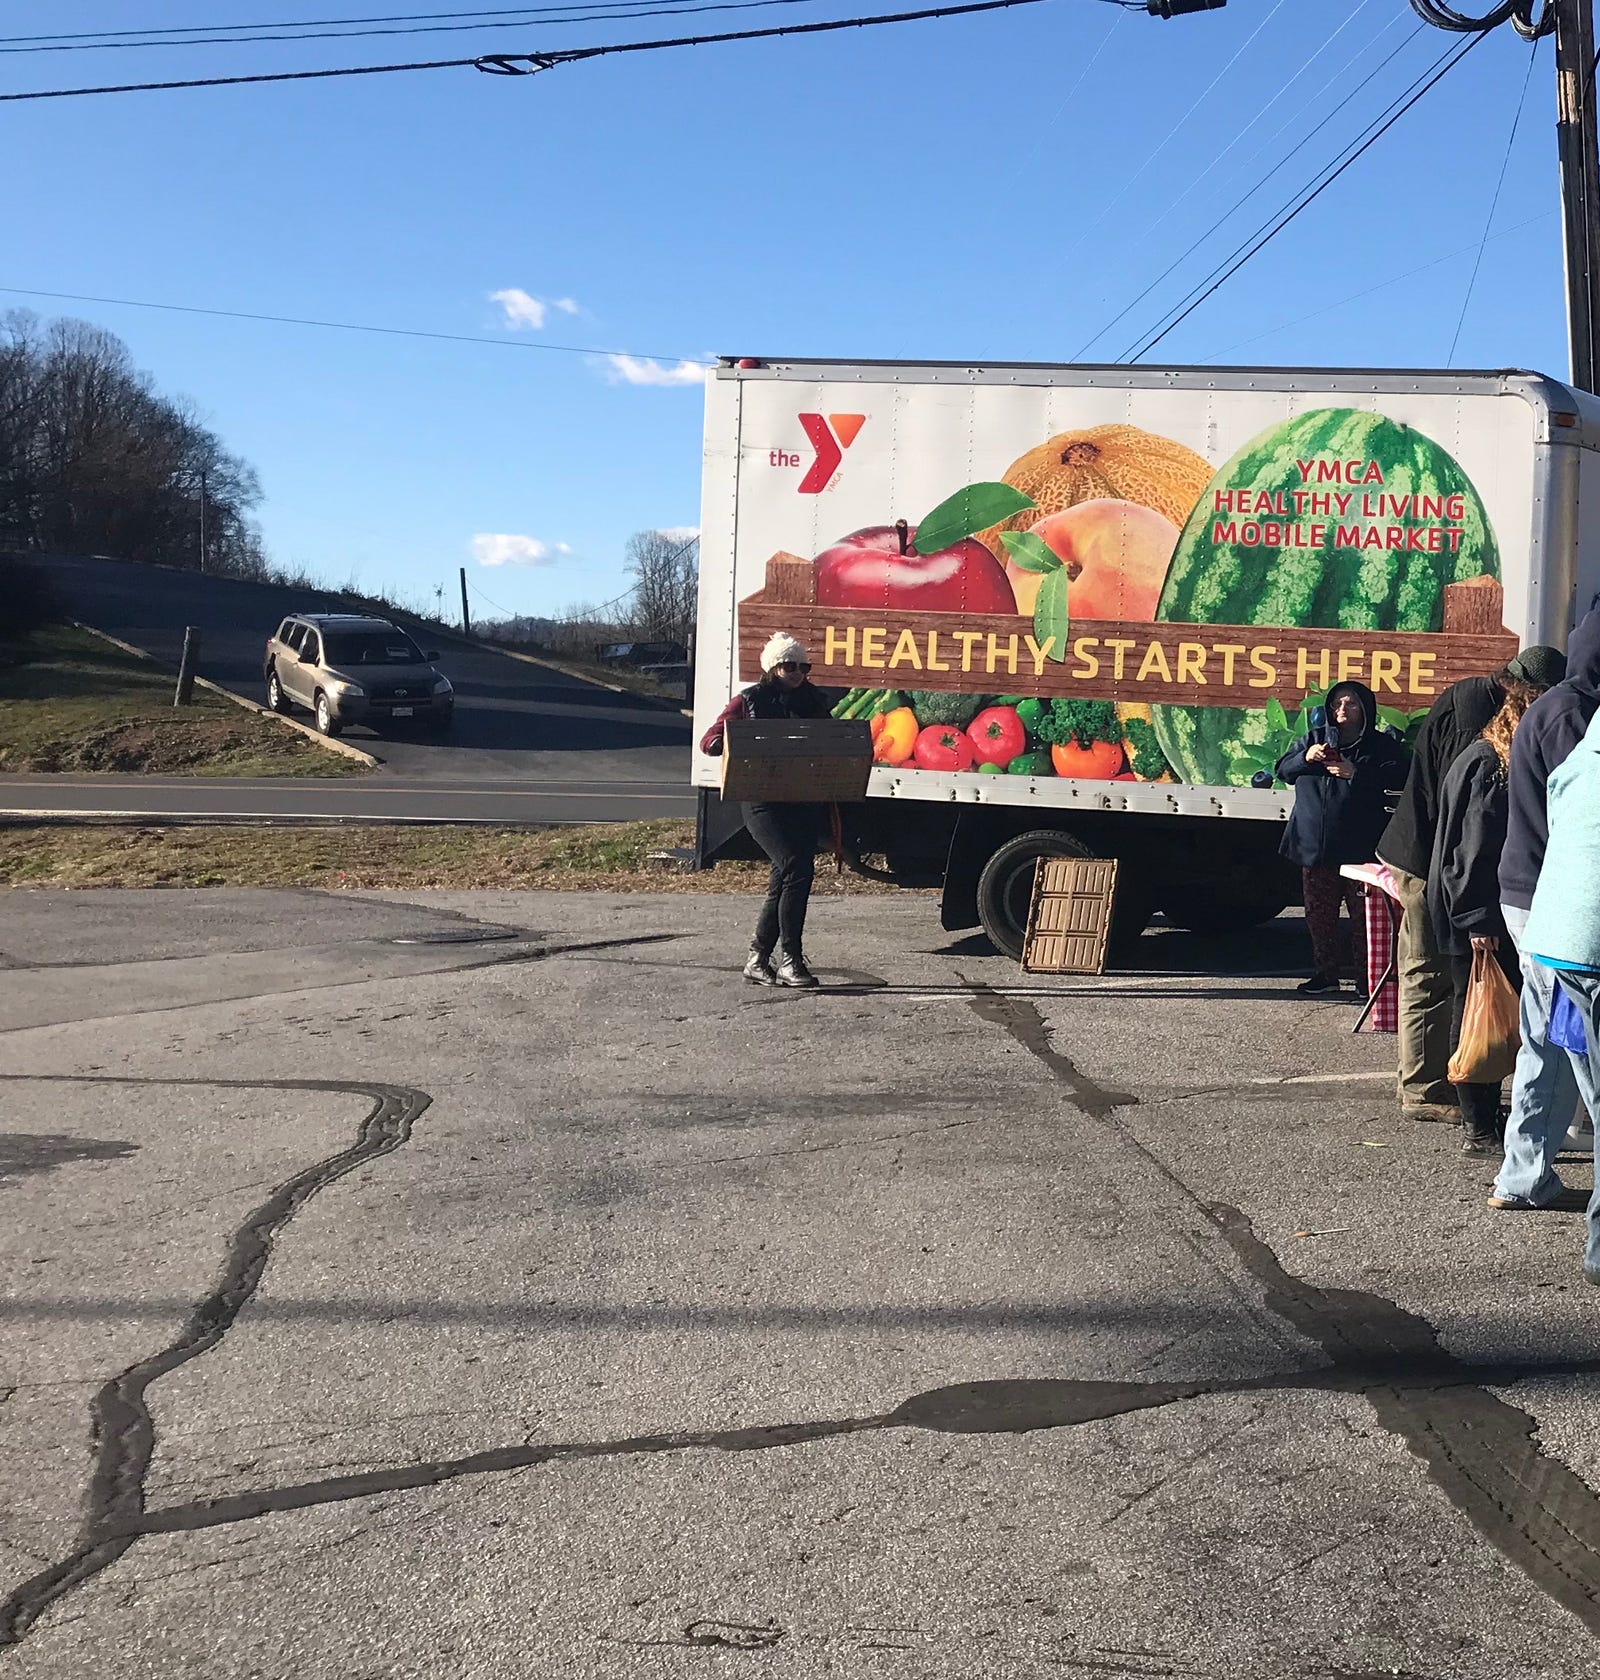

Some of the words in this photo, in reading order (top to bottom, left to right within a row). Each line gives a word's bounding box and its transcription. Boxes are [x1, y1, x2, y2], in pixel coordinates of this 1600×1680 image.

[769, 449, 800, 468] the
[1296, 459, 1383, 486] YMCA
[827, 472, 844, 492] YMCA
[1214, 489, 1354, 517] HEALTHY
[1361, 492, 1465, 521] LIVING
[1212, 521, 1325, 549] MOBILE
[1335, 525, 1464, 554] MARKET
[823, 625, 1056, 677] HEALTHY
[1071, 637, 1277, 687] STARTS
[1296, 647, 1438, 695] HERE
